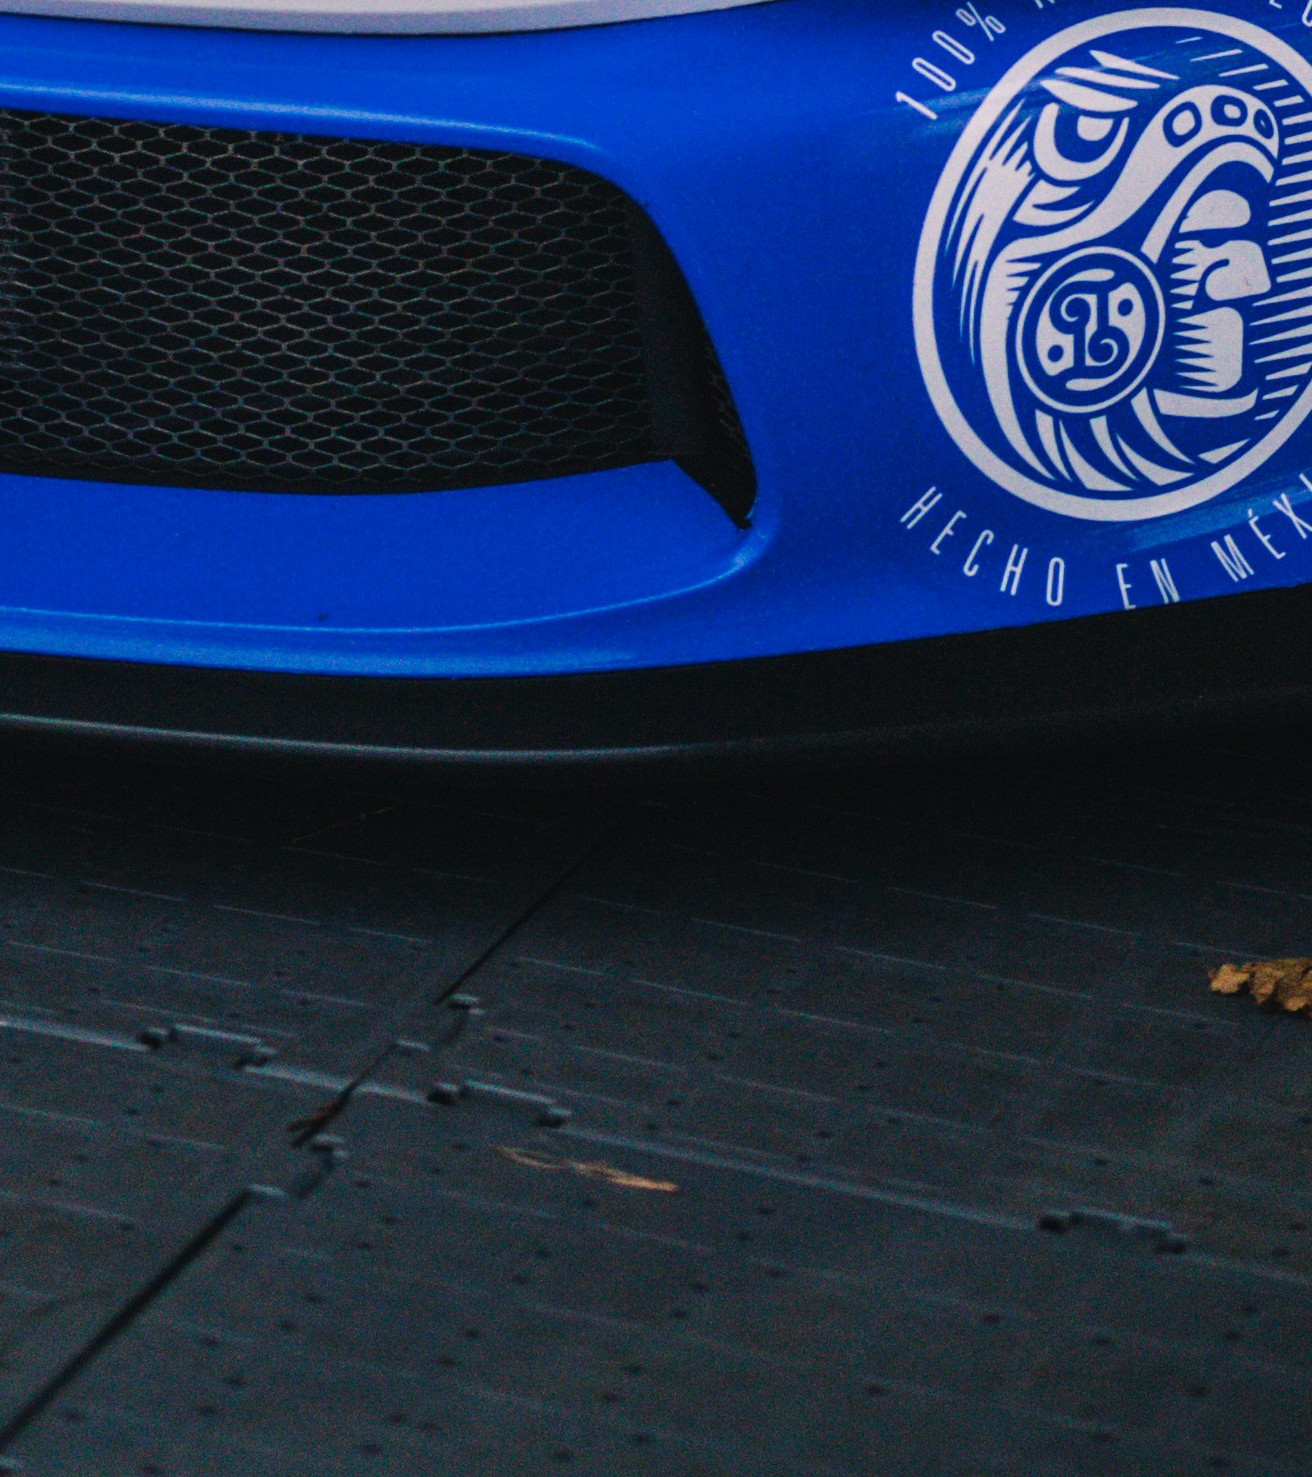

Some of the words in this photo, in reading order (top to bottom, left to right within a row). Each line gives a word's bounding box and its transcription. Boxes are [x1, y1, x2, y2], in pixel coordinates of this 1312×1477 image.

[895, 0, 1005, 120] 100%
[898, 485, 1065, 607] HECHO
[1114, 557, 1182, 610] EN
